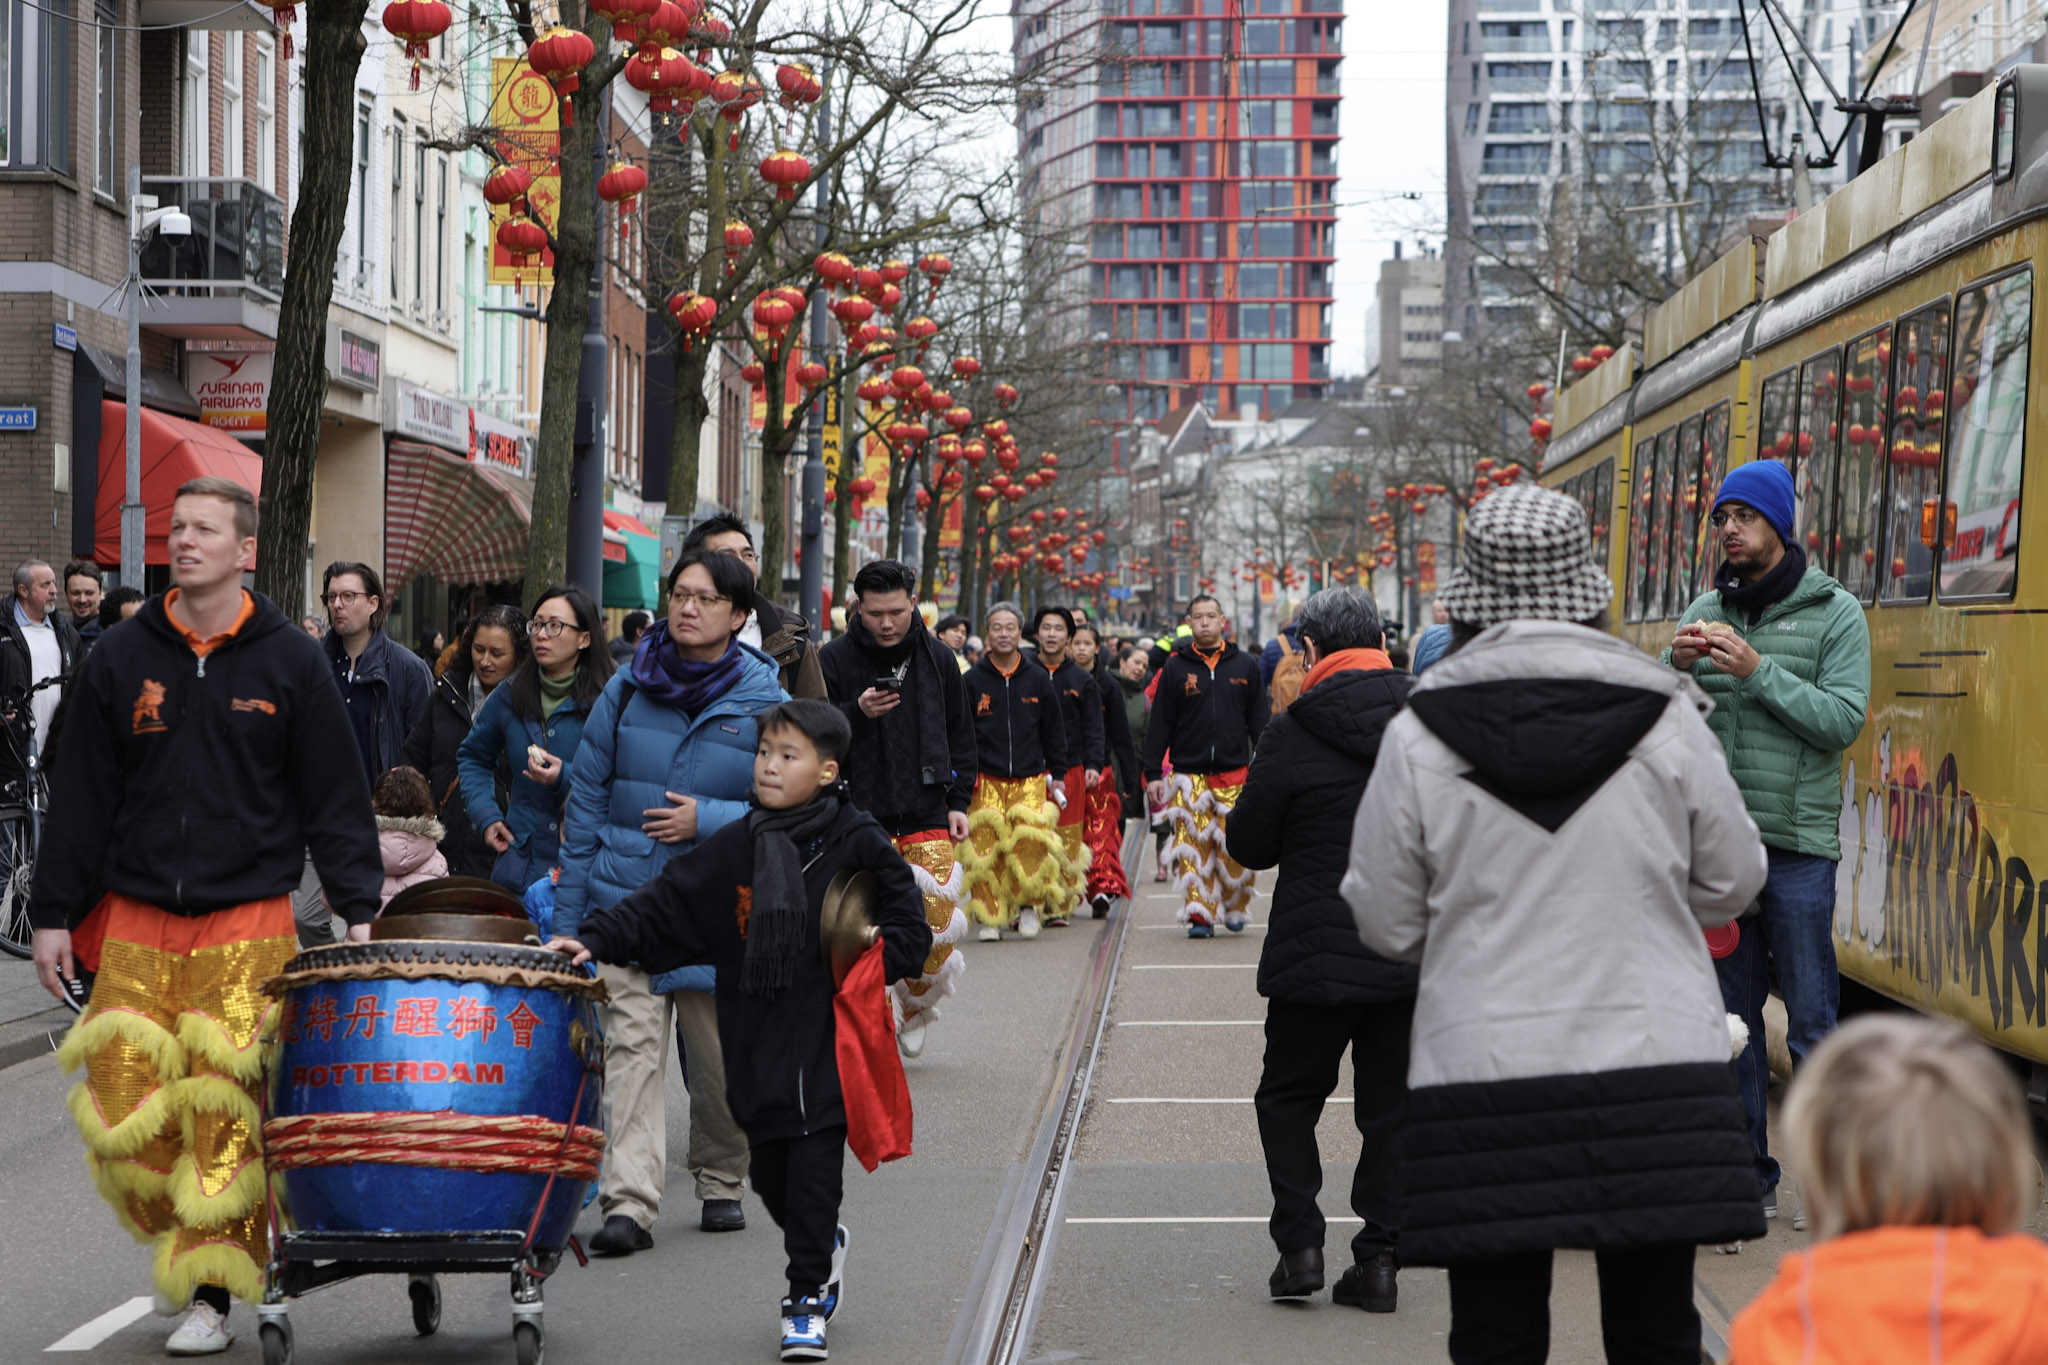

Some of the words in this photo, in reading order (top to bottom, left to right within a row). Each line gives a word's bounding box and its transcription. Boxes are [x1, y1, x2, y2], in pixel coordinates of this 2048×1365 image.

[521, 84, 542, 109] 龍
[197, 382, 264, 395] SURINAM
[200, 396, 262, 409] AIRWAYS
[210, 415, 251, 427] AGENT
[488, 431, 520, 467] SCHELL
[292, 1060, 505, 1088] ROTTERDAM
